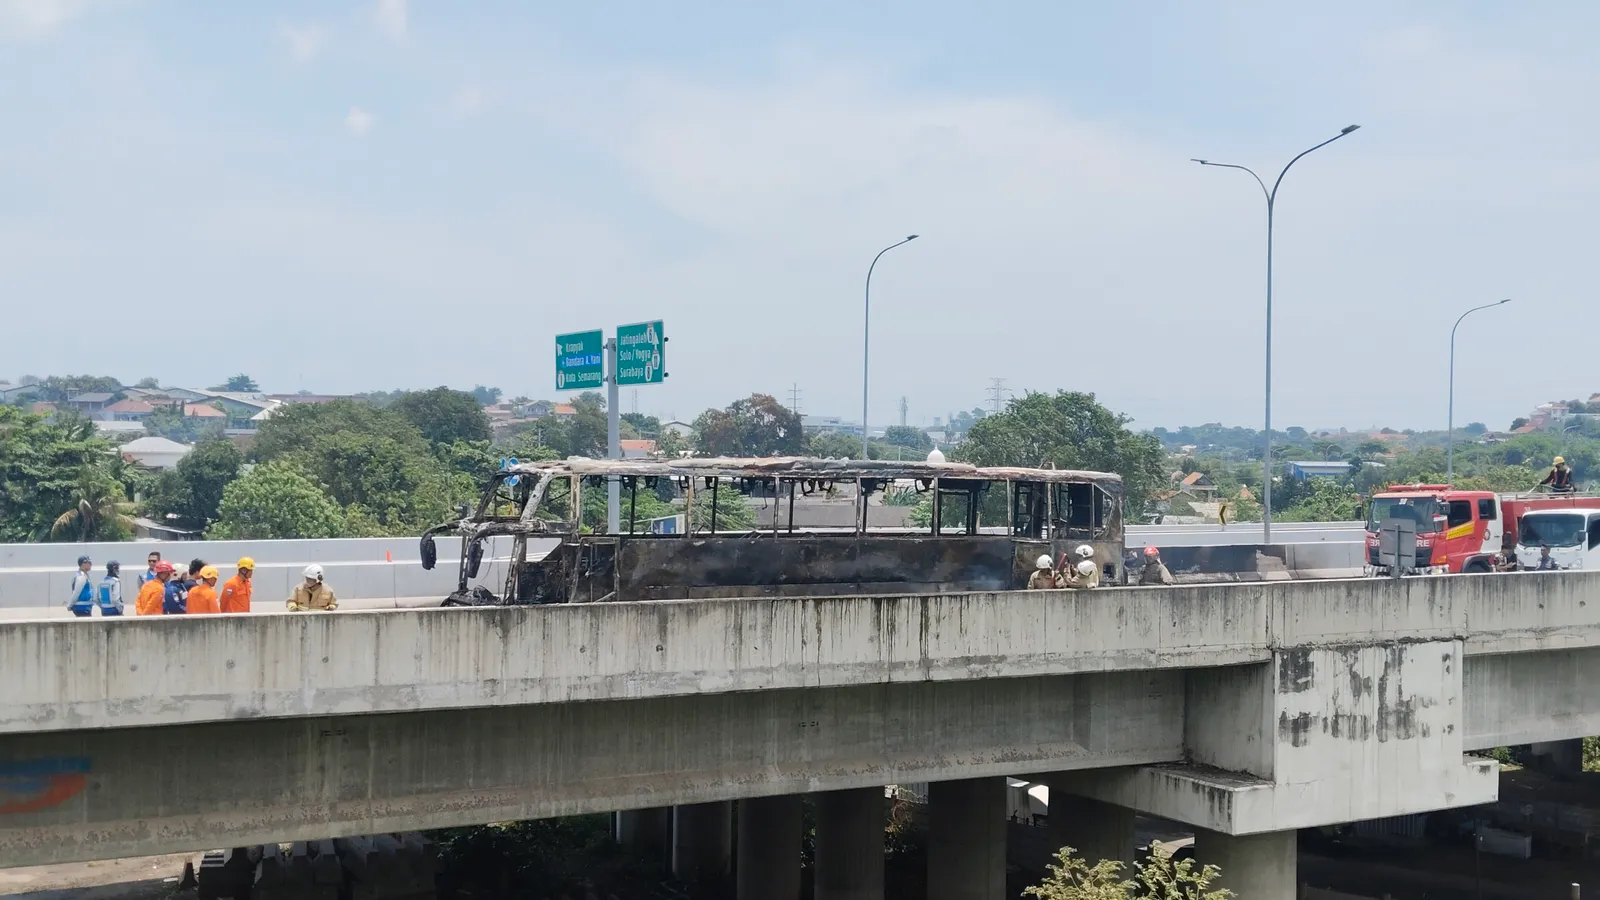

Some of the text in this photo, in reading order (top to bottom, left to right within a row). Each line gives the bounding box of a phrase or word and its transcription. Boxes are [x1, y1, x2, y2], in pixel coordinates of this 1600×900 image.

[620, 333, 648, 347] Jatingaleh
[590, 353, 601, 365] Yani
[620, 349, 631, 361] Solo
[635, 349, 651, 362] Yogya
[566, 373, 576, 382] Kota
[577, 371, 601, 384] Semarang
[620, 366, 644, 380] Surabaya
